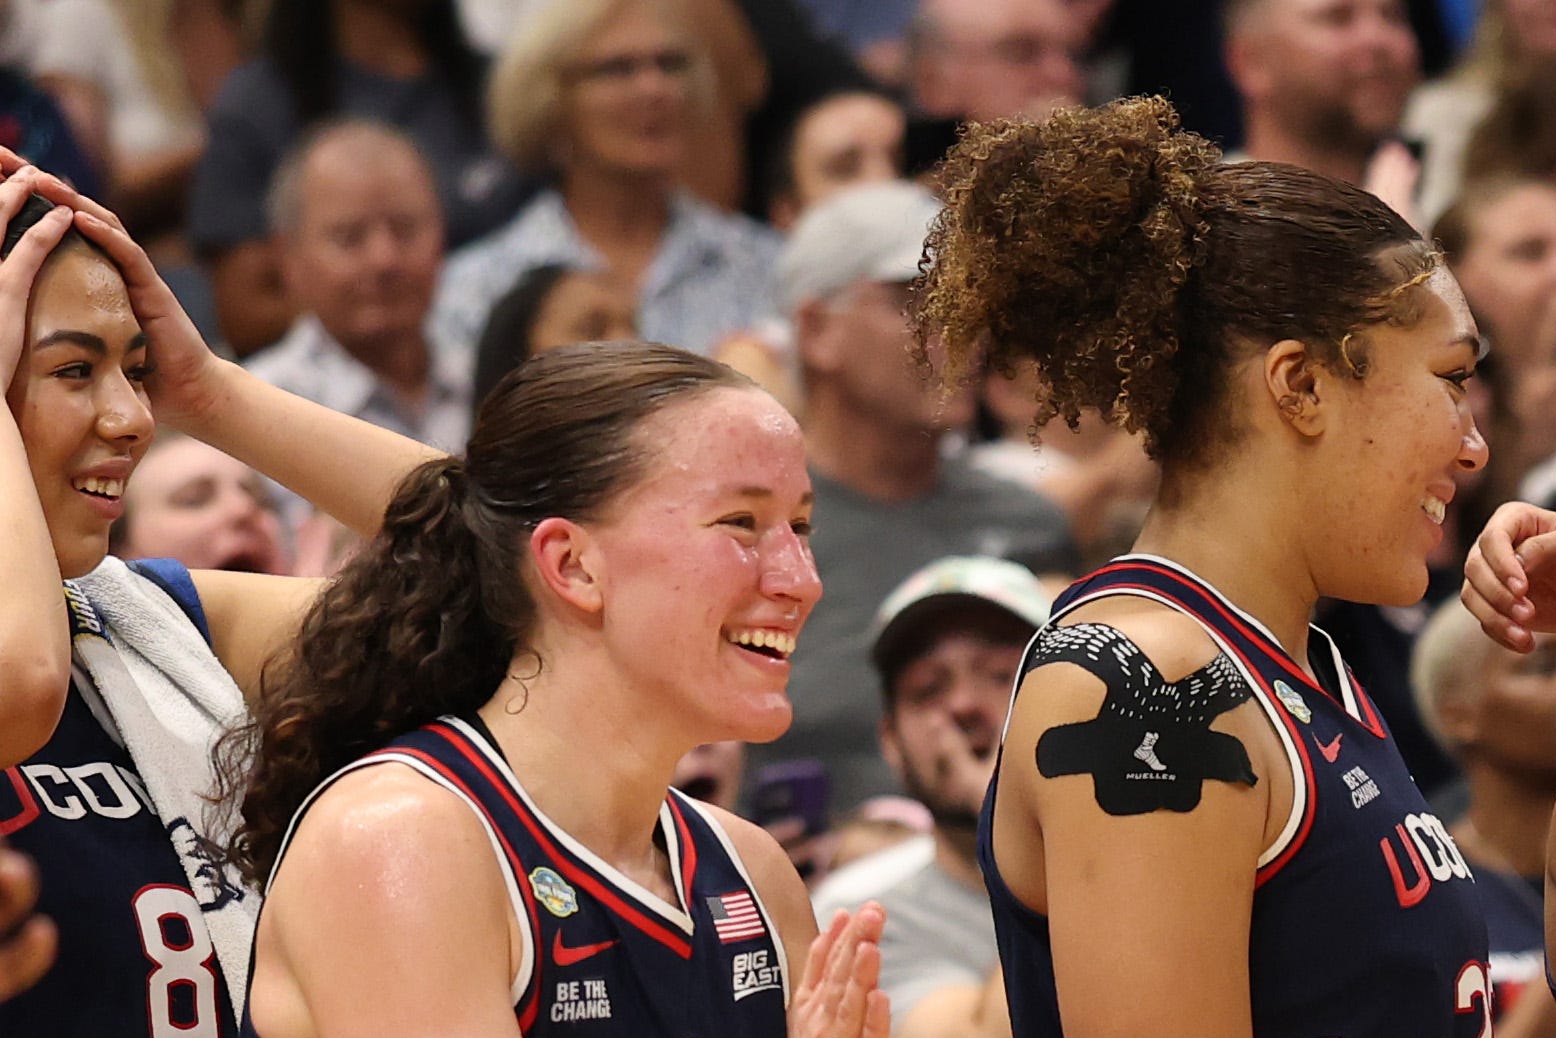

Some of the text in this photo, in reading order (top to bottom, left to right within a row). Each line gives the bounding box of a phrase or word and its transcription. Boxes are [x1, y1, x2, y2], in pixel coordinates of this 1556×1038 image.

[1126, 772, 1177, 781] MUELLER
[733, 950, 768, 973] BIG
[733, 966, 781, 991] EAST
[556, 980, 608, 1002] BE THE
[550, 999, 612, 1023] CHANGE
